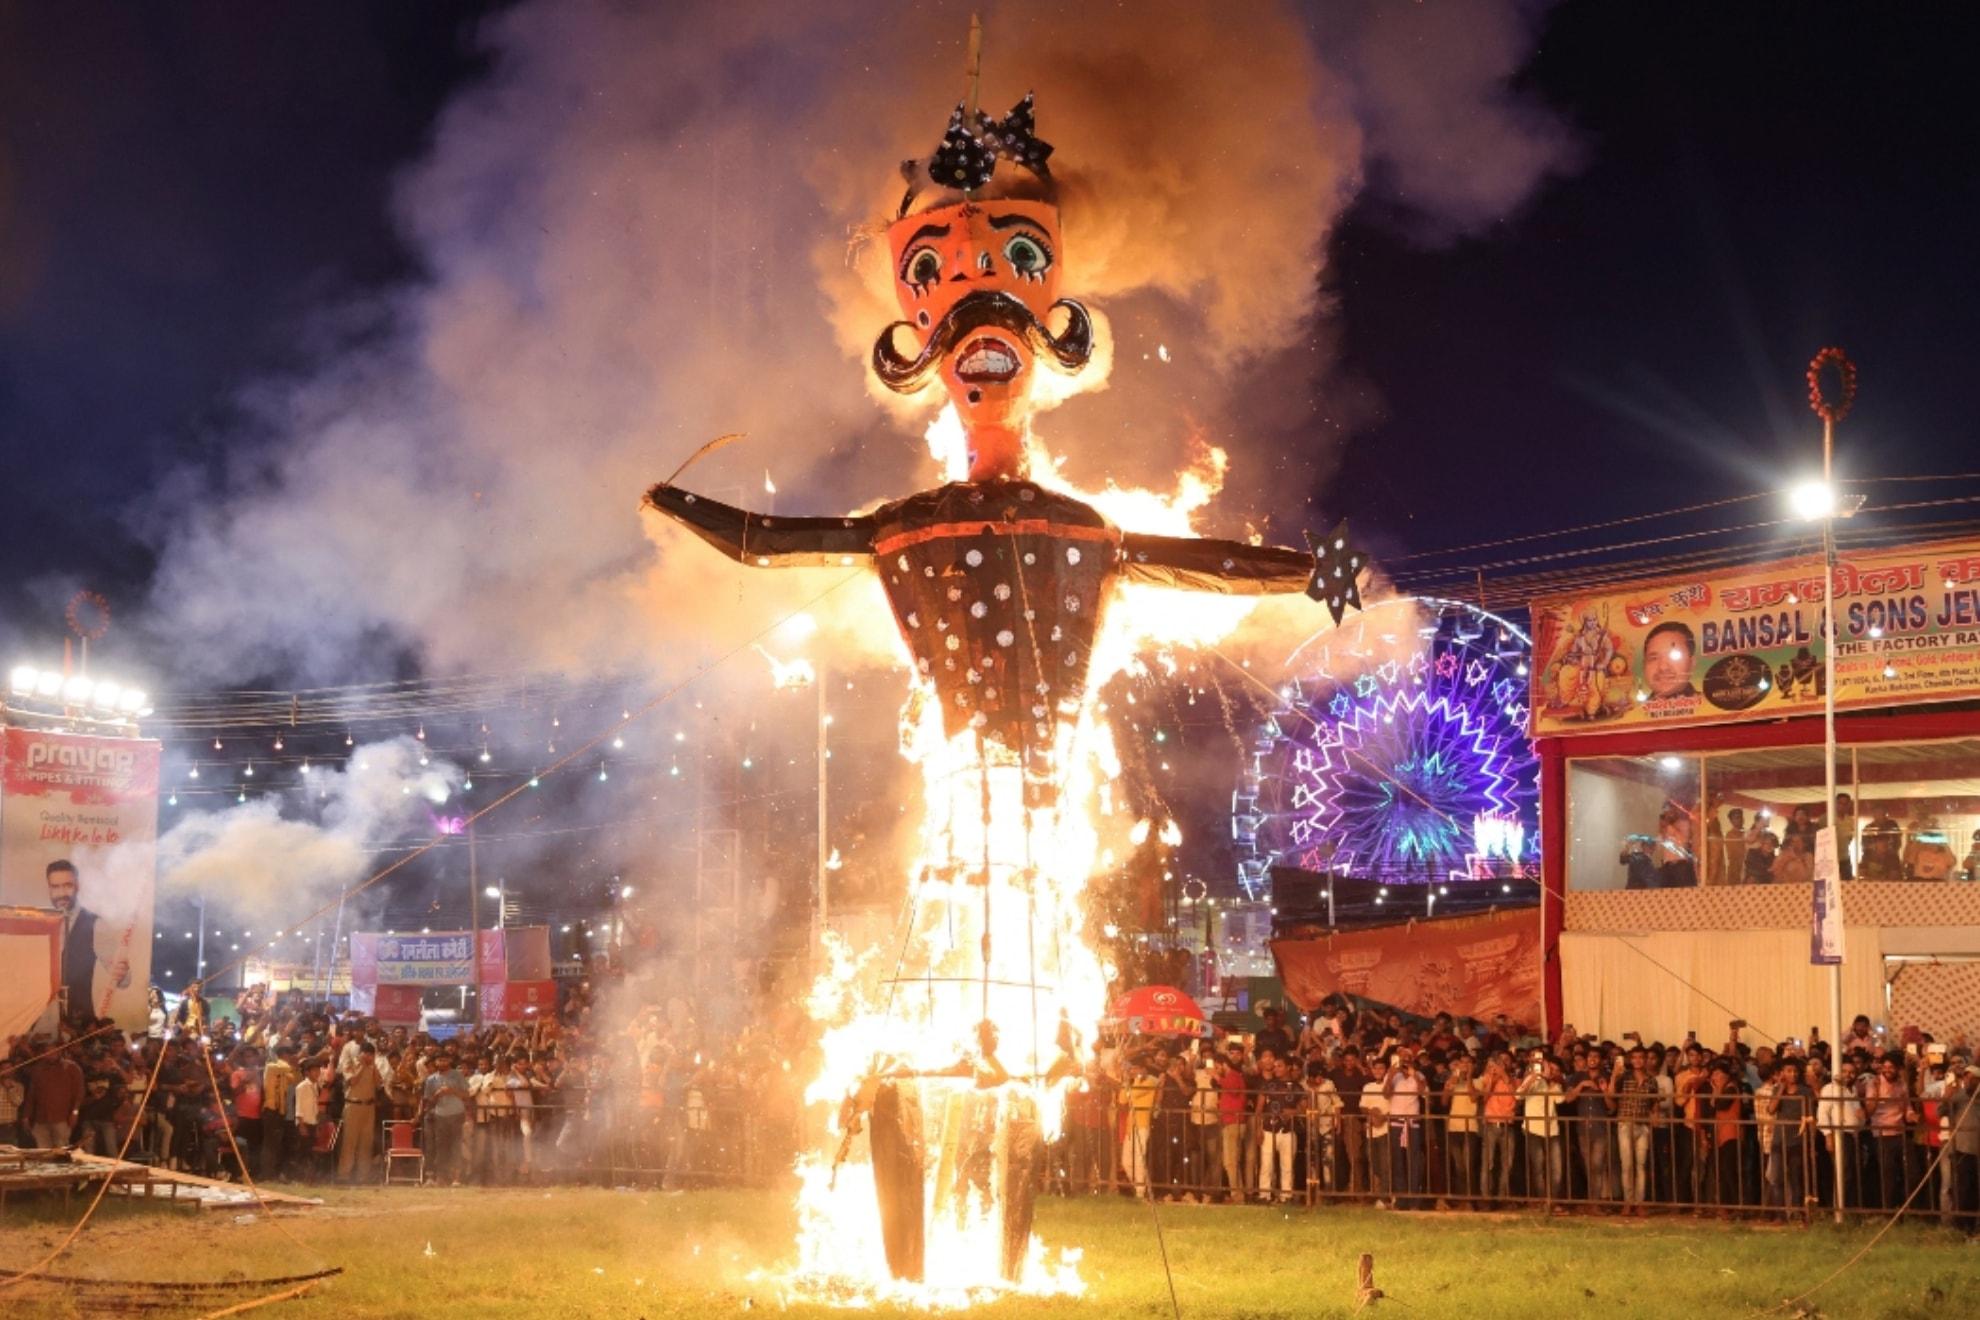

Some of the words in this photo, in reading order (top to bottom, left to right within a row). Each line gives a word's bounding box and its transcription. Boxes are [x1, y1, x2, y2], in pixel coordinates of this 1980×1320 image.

[1702, 610, 1810, 654] BANSAL
[1848, 595, 1927, 634] SONS
[1836, 642, 1868, 656] THE
[1873, 634, 1950, 651] FACTORY
[1956, 632, 1980, 644] RA
[27, 742, 134, 776] prayag
[29, 770, 63, 785] PIPES
[64, 773, 74, 785] &
